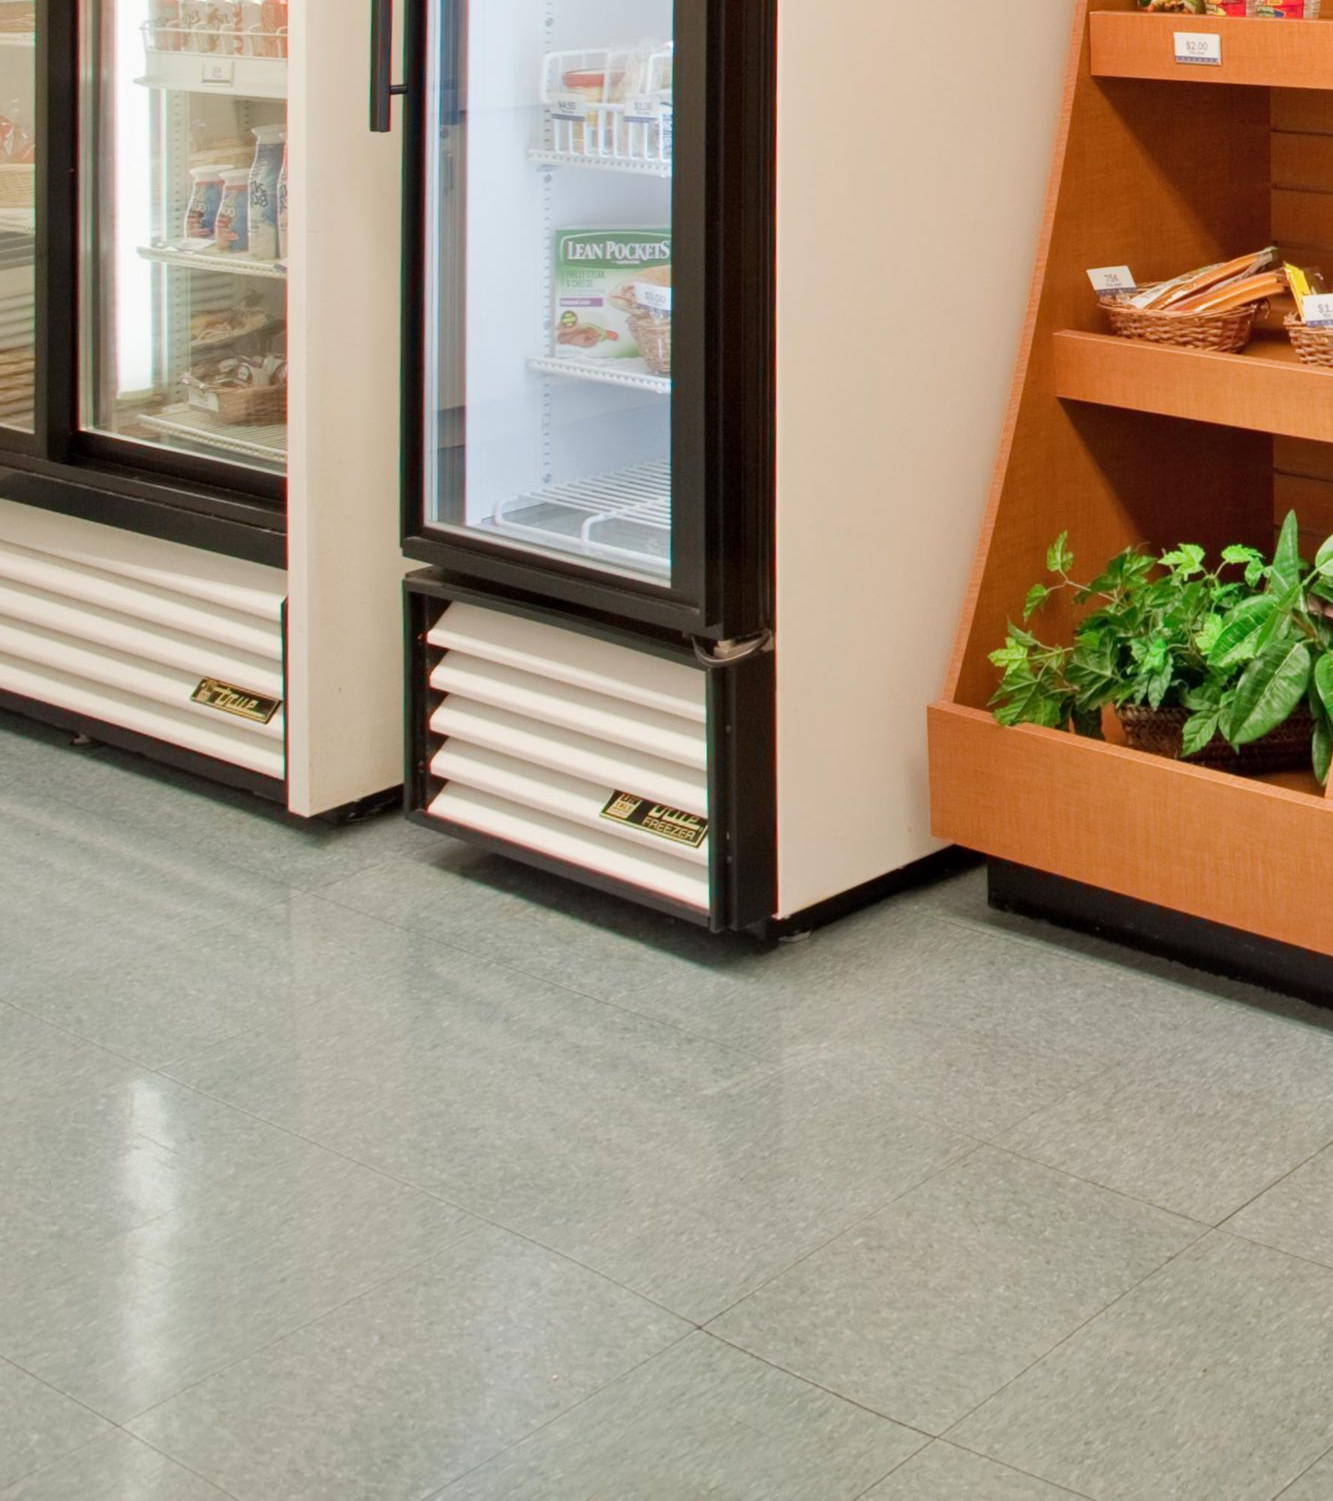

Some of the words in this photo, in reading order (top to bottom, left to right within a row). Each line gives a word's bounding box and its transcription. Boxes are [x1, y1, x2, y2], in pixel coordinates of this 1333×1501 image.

[1185, 40, 1209, 52] $2.00
[567, 240, 603, 260] LEAN
[605, 240, 671, 261] POCKETS
[213, 687, 259, 711] true
[641, 815, 697, 841] FREEZER
